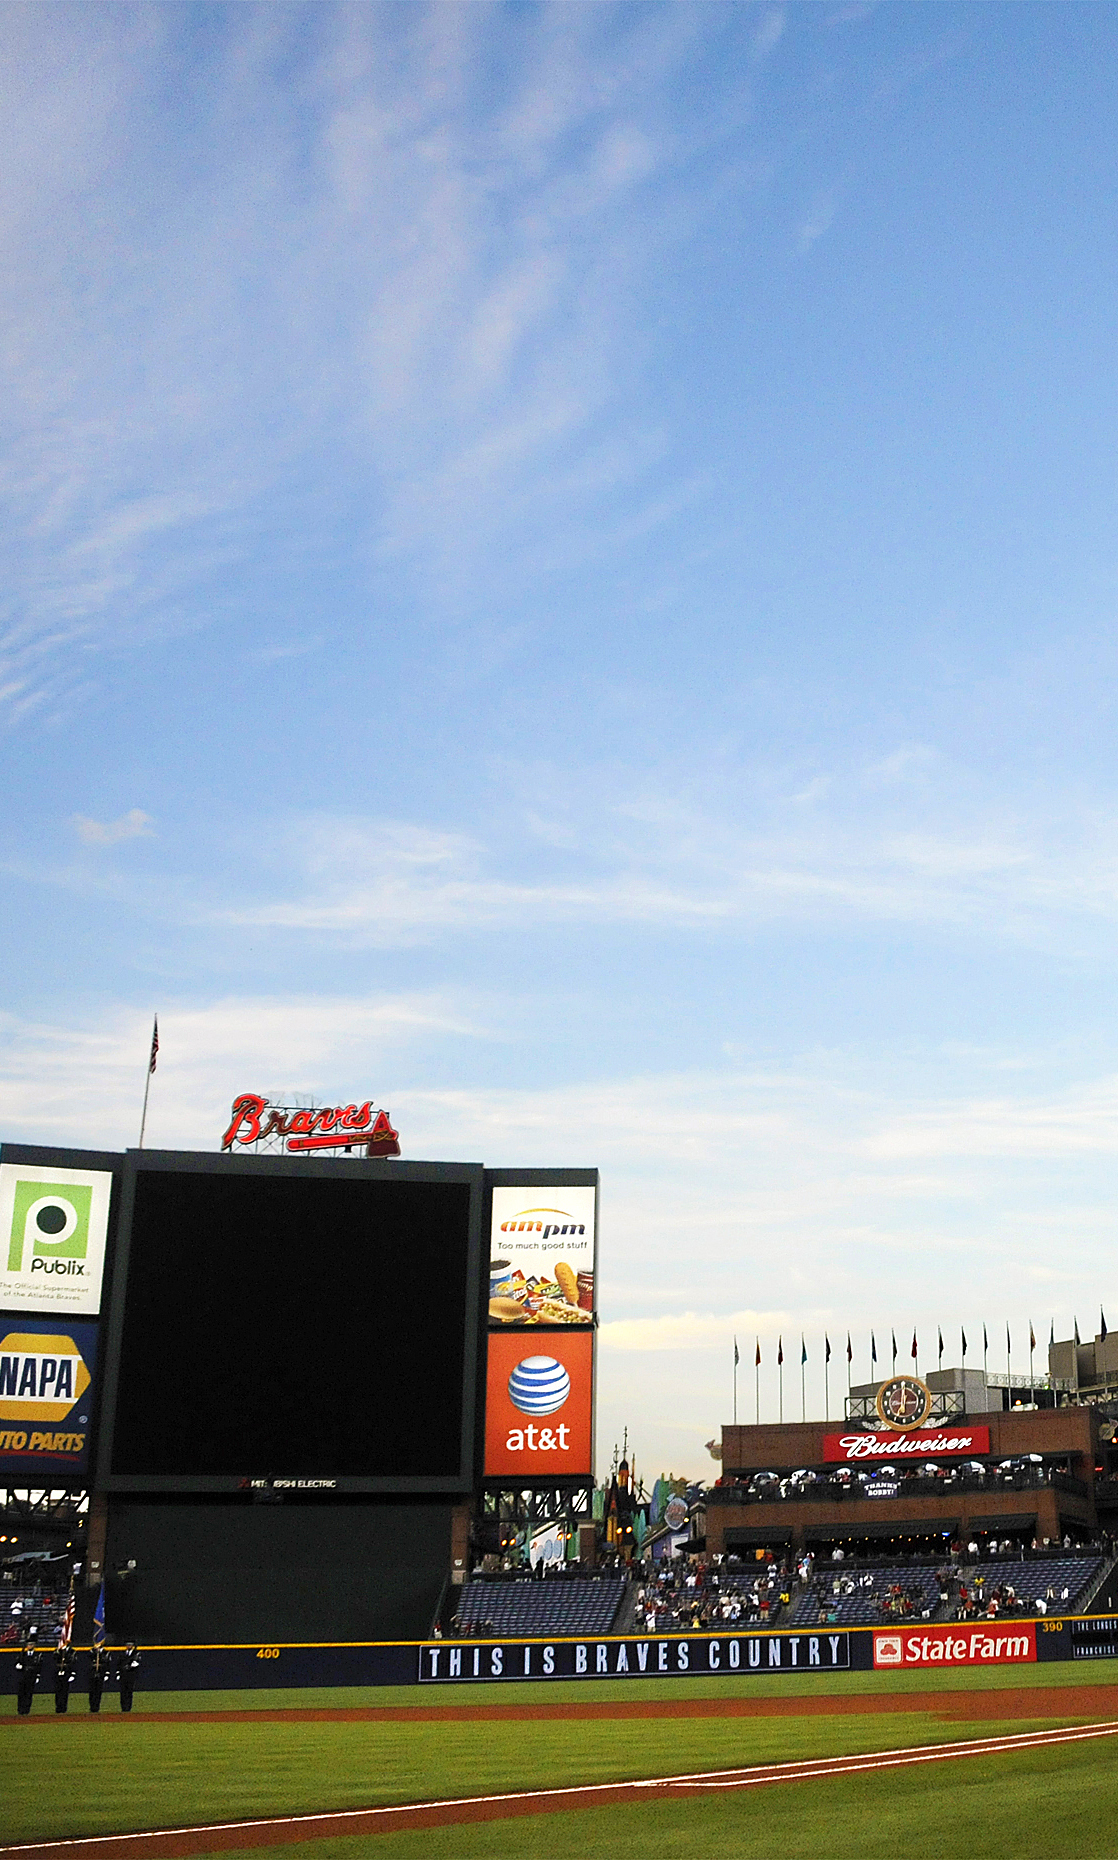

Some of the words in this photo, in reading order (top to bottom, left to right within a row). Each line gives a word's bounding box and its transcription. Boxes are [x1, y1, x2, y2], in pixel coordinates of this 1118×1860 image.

[221, 1093, 373, 1150] Braves
[500, 1220, 586, 1240] ampm
[497, 1241, 514, 1250] Too
[515, 1241, 540, 1250] much
[541, 1241, 565, 1251] good
[566, 1241, 588, 1250] stuff
[30, 1257, 86, 1277] Publix
[14, 1282, 40, 1290] Official
[43, 1285, 90, 1293] Supermarket
[27, 1292, 55, 1300] Atlanta
[0, 1356, 72, 1398] NAPA
[28, 1431, 86, 1452] PARTS
[505, 1423, 571, 1451] at&t
[839, 1433, 973, 1459] Budweiser
[297, 1479, 337, 1488] ELECTRIC
[1042, 1621, 1063, 1633] 390
[1077, 1622, 1089, 1631] THE
[256, 1648, 280, 1659] 400
[428, 1647, 504, 1677] THIS
[524, 1646, 555, 1675] IS
[575, 1642, 689, 1673] BRAVES
[708, 1636, 841, 1670] COUNTRY
[905, 1636, 967, 1662] State
[969, 1633, 1029, 1659] Farm
